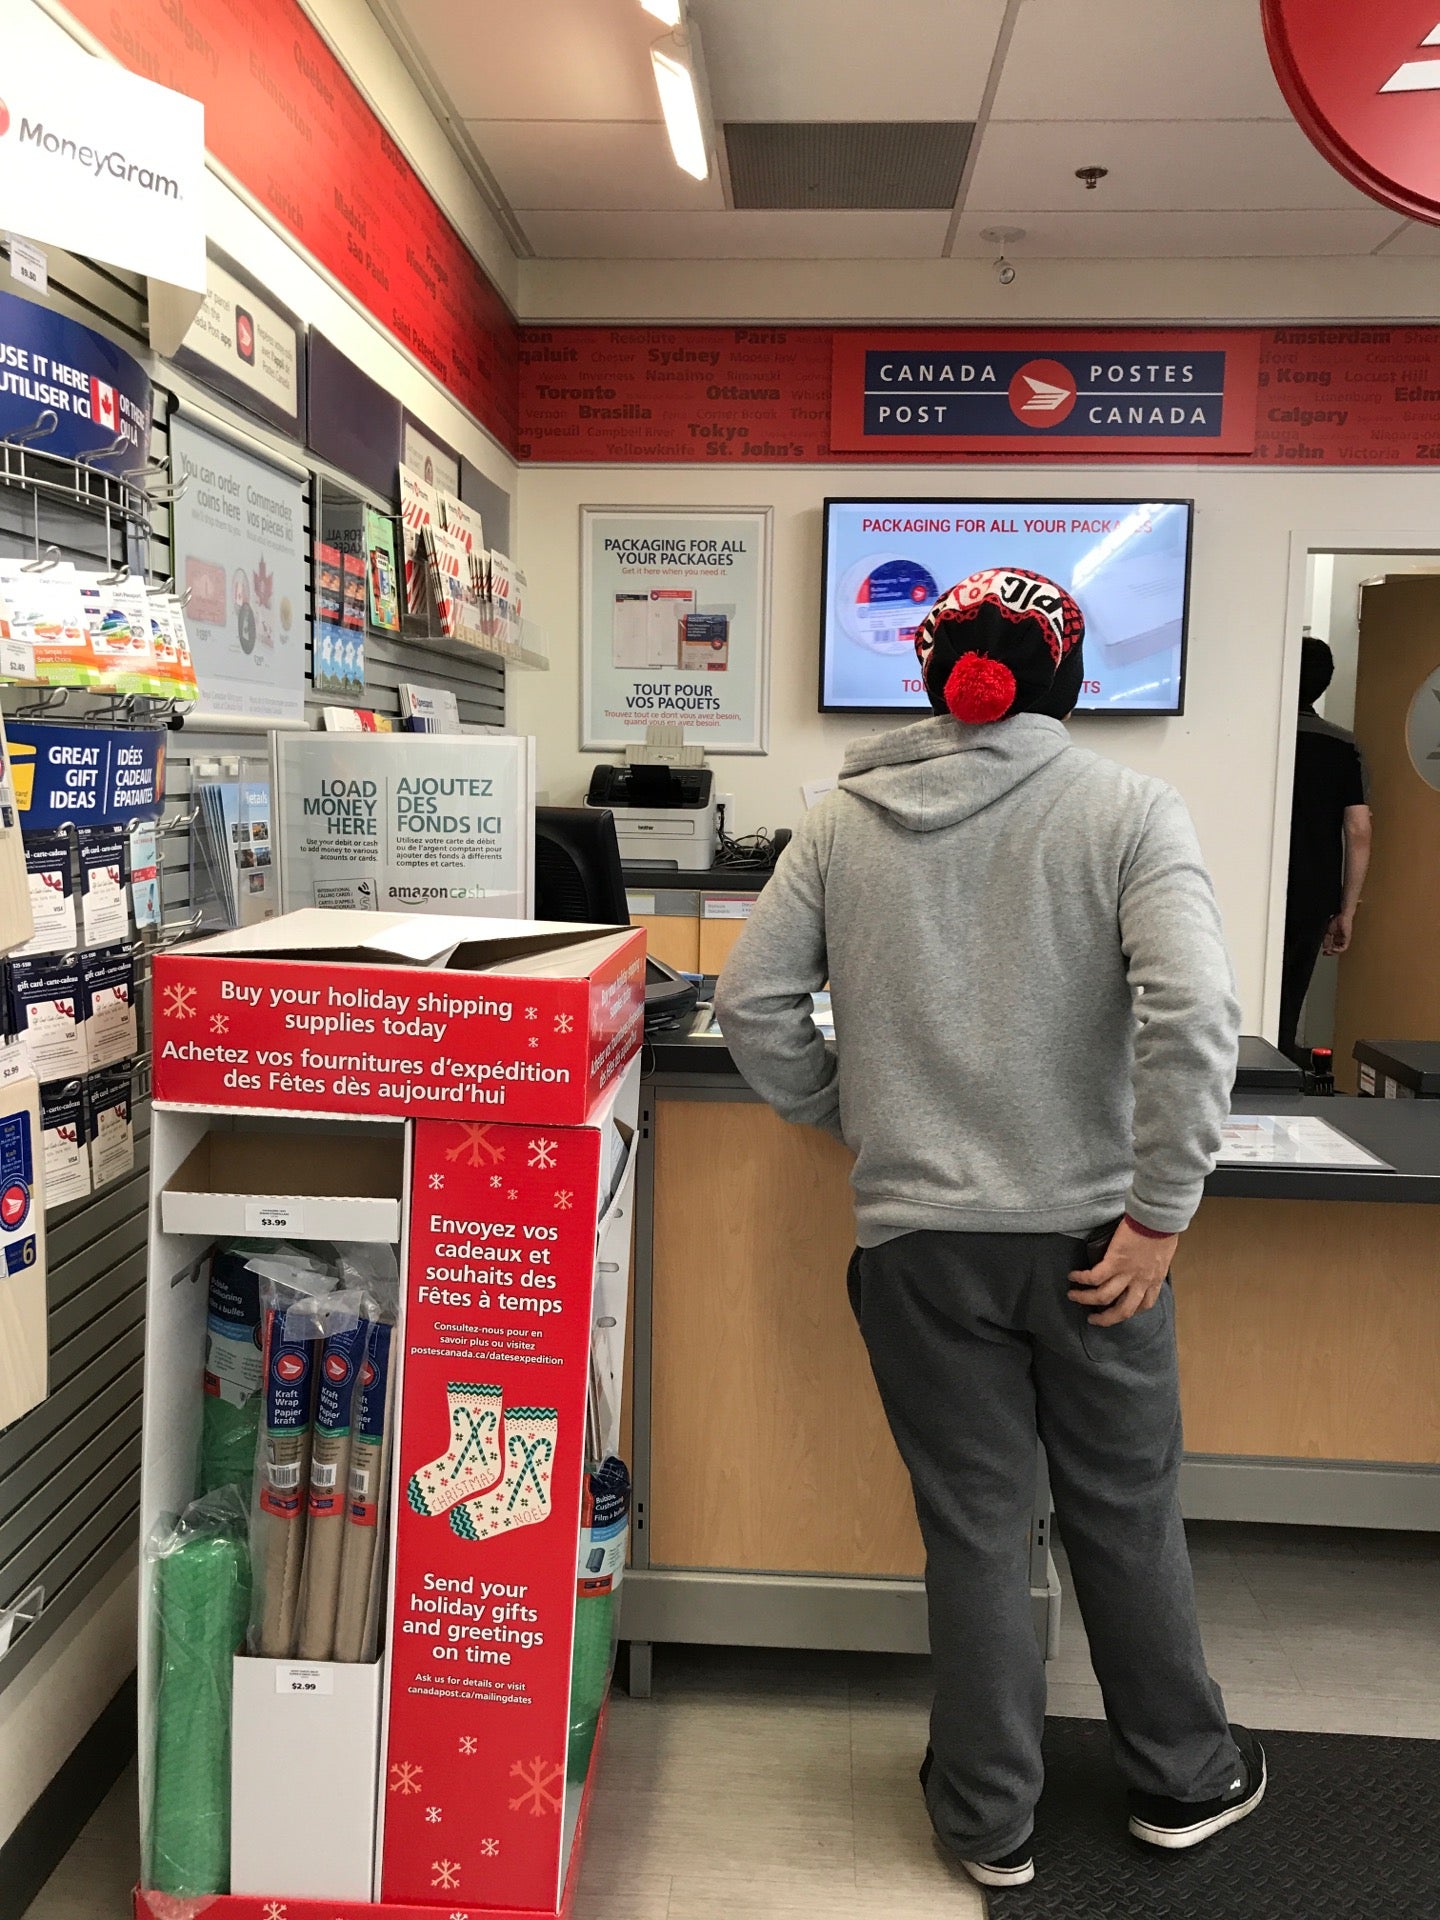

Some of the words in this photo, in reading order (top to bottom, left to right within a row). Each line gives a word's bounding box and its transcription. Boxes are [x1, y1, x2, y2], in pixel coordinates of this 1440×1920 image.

[20, 118, 178, 199] MoneyGram
[335, 186, 367, 241] Madrid
[220, 333, 233, 350] app
[734, 331, 787, 344] Paris
[1273, 329, 1391, 344] Amsterdam
[647, 348, 720, 366] Sydney
[33, 353, 49, 378] IT
[52, 360, 90, 395] HERE
[645, 369, 714, 381] Nanaimo
[879, 364, 998, 383] CANADA
[1089, 364, 1195, 383] POSTES
[1277, 368, 1332, 387] Kong
[0, 371, 70, 413] UTILISER
[73, 395, 91, 420] ICI
[536, 385, 616, 400] Toronto
[706, 386, 780, 400] Ottawa
[120, 393, 132, 415] OR
[579, 405, 652, 419] Brasilia
[878, 405, 948, 425] POST
[1088, 406, 1208, 426] CANADA
[1267, 407, 1348, 427] Calgary
[688, 424, 748, 441] Tokyo
[607, 443, 695, 456] Yellowknife
[706, 442, 733, 456] St.
[741, 442, 804, 457] John's
[1274, 443, 1324, 459] John
[1336, 446, 1401, 459] Victoria
[180, 451, 199, 480] You
[200, 465, 216, 483] can
[218, 472, 241, 498] order
[197, 489, 221, 514] coins
[222, 495, 241, 521] here
[246, 484, 294, 522] Commandez
[246, 510, 260, 529] vos
[863, 518, 951, 534] PACKAGING
[955, 518, 986, 534] FOR
[990, 519, 1019, 534] ALL
[1024, 519, 1067, 534] YOUR
[604, 539, 687, 552] PACKAGING
[690, 540, 717, 552] FOR
[721, 540, 747, 553] ALL
[616, 552, 656, 565] YOUR
[660, 553, 734, 566] PACKAGES
[643, 567, 661, 576] here
[662, 567, 683, 576] when
[684, 569, 698, 577] you
[700, 568, 718, 576] need
[633, 683, 671, 696] TOUT
[674, 684, 713, 697] POUR
[626, 696, 655, 709] VOS
[658, 696, 721, 711] PAQUETS
[604, 709, 633, 718] Trouvez
[48, 746, 100, 767] GREAT
[117, 746, 143, 768] IDÉES
[65, 768, 98, 787] GIFT
[115, 768, 153, 788] CADEAUX
[320, 780, 378, 798] LOAD
[396, 777, 494, 797] AJOUTEZ
[50, 791, 96, 809] IDEAS
[113, 787, 154, 810] ÉPATANTES
[303, 797, 378, 817] MONEY
[396, 796, 437, 814] DES
[327, 817, 377, 836] HERE
[396, 815, 471, 834] FONDS
[477, 817, 502, 834] ICI
[335, 839, 352, 847] debit
[396, 836, 423, 844] Utilisez
[425, 837, 444, 845] votre
[396, 852, 422, 860] ajouter
[438, 852, 460, 860] fonds
[467, 852, 503, 861] différents
[448, 846, 484, 854] comptant
[396, 860, 429, 868] comptes
[17, 979, 30, 992] gift
[30, 976, 44, 989] card
[46, 974, 79, 987] carte-cadeau
[84, 971, 95, 983] gift
[221, 981, 263, 1006] Buy
[269, 987, 322, 1008] your
[327, 986, 411, 1014] holiday
[416, 995, 513, 1021] shipping
[285, 1010, 375, 1034] supplies
[382, 1017, 448, 1041] today
[3, 1065, 19, 1079] $2.99
[161, 1041, 249, 1063] Achetez
[256, 1048, 293, 1067] vos
[301, 1046, 424, 1076] fournitures
[430, 1055, 570, 1085] d'expédition
[223, 1068, 261, 1090] des
[269, 1070, 326, 1094] Fêtes
[332, 1074, 371, 1097] dès
[378, 1077, 507, 1106] aujourd'hui
[261, 1218, 287, 1227] $3.99
[429, 1214, 516, 1241] Envoyez
[522, 1225, 559, 1241] vos
[23, 1238, 34, 1265] 6
[434, 1240, 522, 1263] cadeaux
[528, 1246, 551, 1265] et
[425, 1264, 514, 1286] souhaits
[520, 1269, 557, 1289] des
[418, 1285, 471, 1307] Fêtes
[478, 1289, 491, 1308] à
[497, 1292, 563, 1316] temps
[222, 1305, 245, 1317] bulles
[433, 1321, 504, 1336] Consultez-nous
[506, 1327, 528, 1340] pour
[531, 1330, 543, 1338] en
[440, 1335, 467, 1345] savoir
[469, 1337, 489, 1348] plus
[491, 1340, 504, 1348] ou
[506, 1339, 536, 1351] visitez
[410, 1346, 564, 1366] postescanada.ca/datesexpedition
[275, 1389, 298, 1399] Kraft
[320, 1394, 338, 1410] Wrap
[321, 1387, 338, 1401] Kraft
[275, 1398, 299, 1409] Wrap
[320, 1404, 341, 1419] Papier
[274, 1417, 297, 1426] kraft
[275, 1407, 303, 1419] Papier
[431, 1468, 496, 1513] CHRISTMAS
[594, 1512, 609, 1522] Film
[423, 1572, 474, 1594] Send
[480, 1581, 528, 1599] your
[410, 1592, 486, 1621] holiday
[491, 1602, 538, 1624] gifts
[402, 1618, 442, 1636] and
[447, 1624, 544, 1649] greetings
[432, 1645, 459, 1660] on
[465, 1645, 511, 1665] time
[292, 1682, 317, 1691] $2.99
[415, 1673, 433, 1682] Ask
[447, 1675, 461, 1685] for
[462, 1676, 493, 1688] details
[494, 1681, 506, 1689] or
[507, 1681, 526, 1691] visit
[407, 1685, 533, 1705] canadapost.ca/mailingdates
